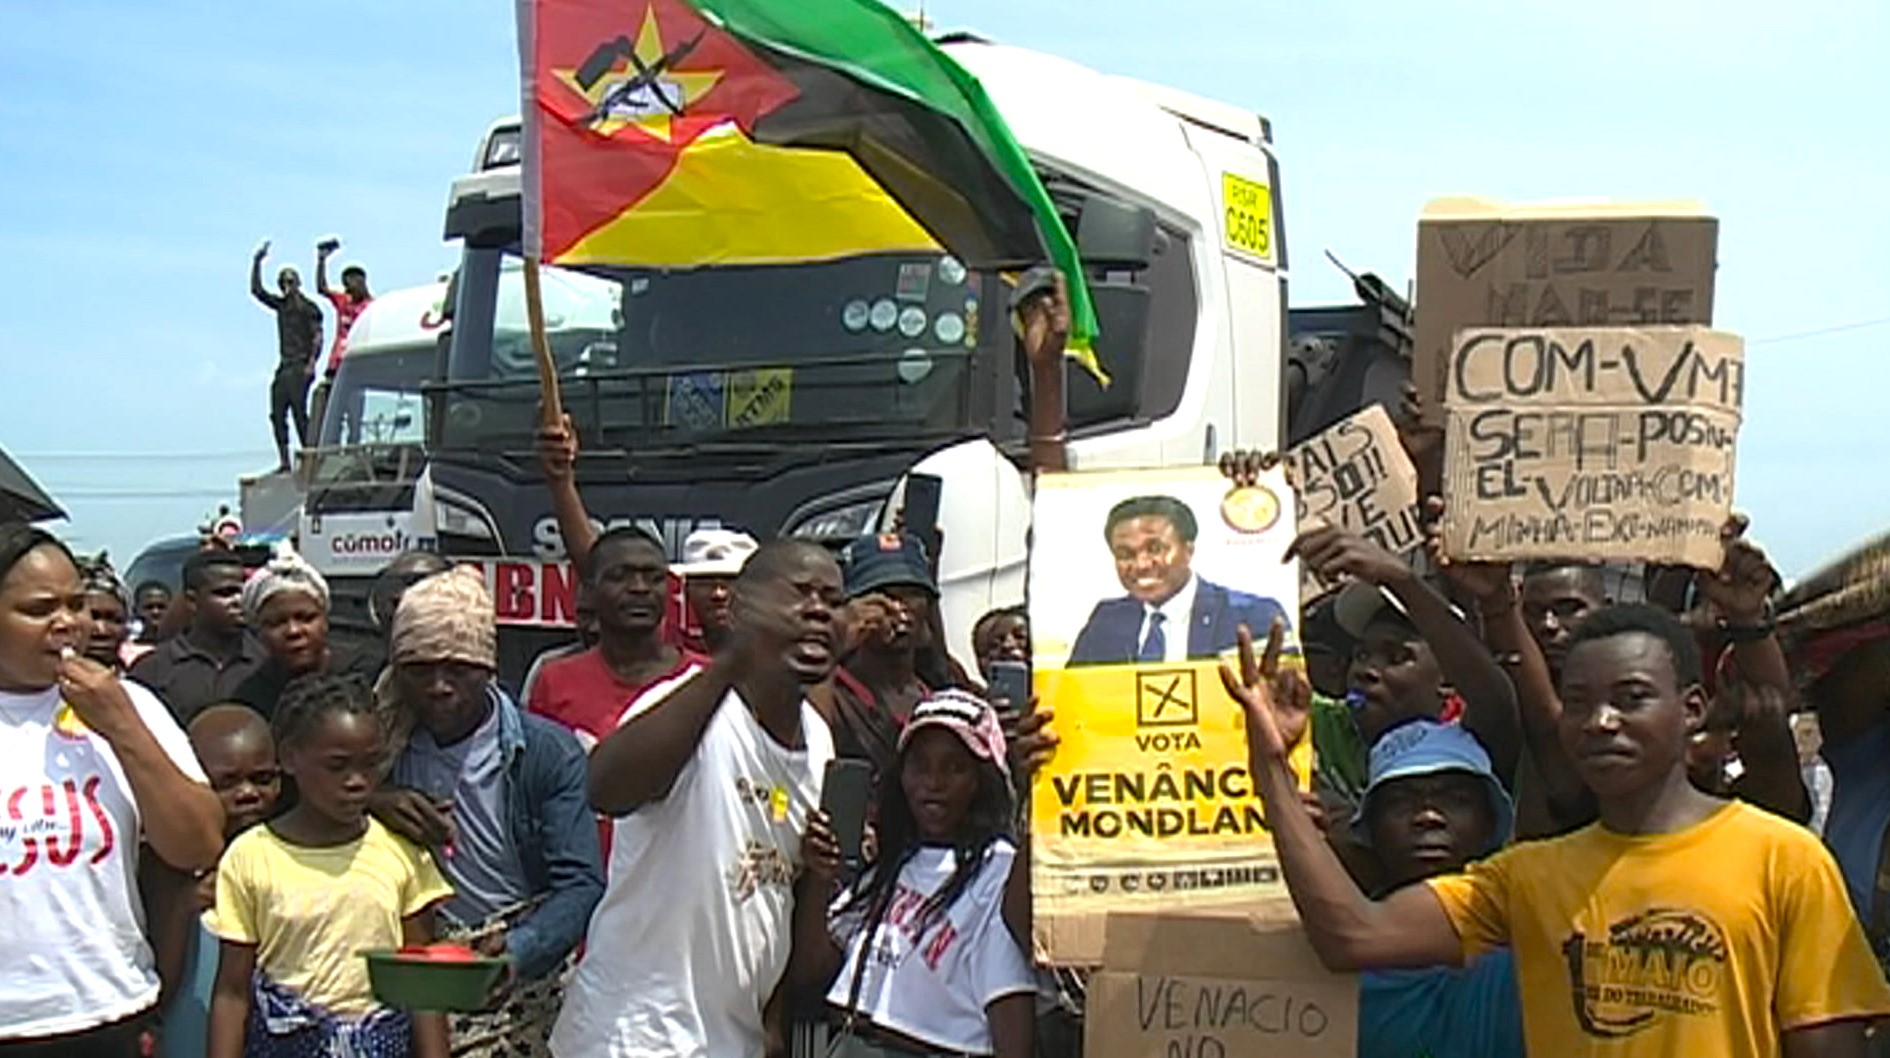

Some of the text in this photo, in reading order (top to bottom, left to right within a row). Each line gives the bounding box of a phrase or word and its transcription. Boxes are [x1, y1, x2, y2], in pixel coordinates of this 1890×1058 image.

[1227, 206, 1268, 252] C605
[1136, 732, 1201, 752] VOTA
[1052, 763, 1250, 804] VENÂNC
[1137, 976, 1328, 1037] VENACIO
